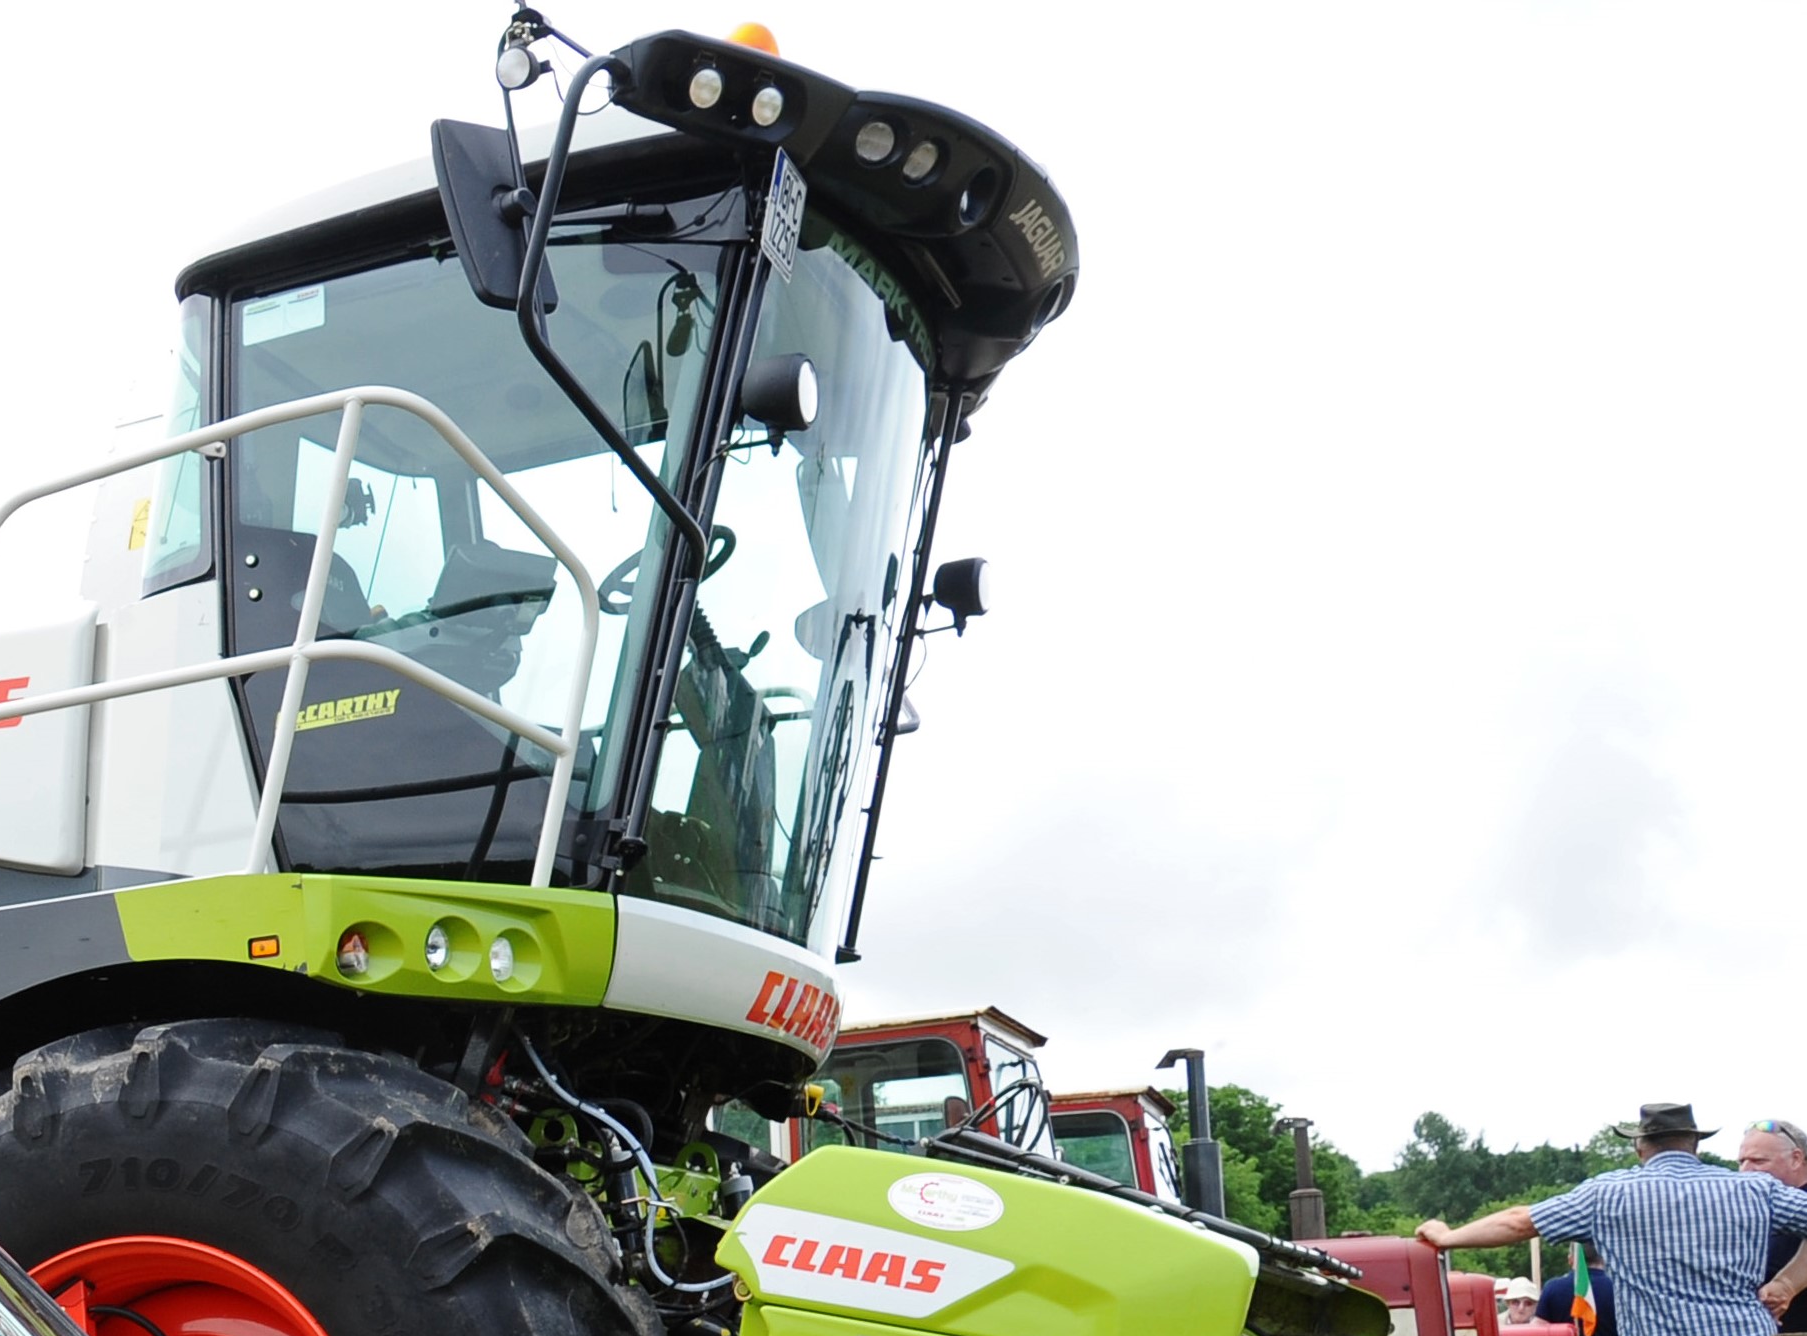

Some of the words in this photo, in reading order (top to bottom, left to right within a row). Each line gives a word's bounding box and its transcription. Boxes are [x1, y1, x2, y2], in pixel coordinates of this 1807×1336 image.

[1008, 199, 1067, 278] JAGUAR
[78, 1156, 302, 1233] 710/70
[761, 1234, 947, 1294] CLAAS
